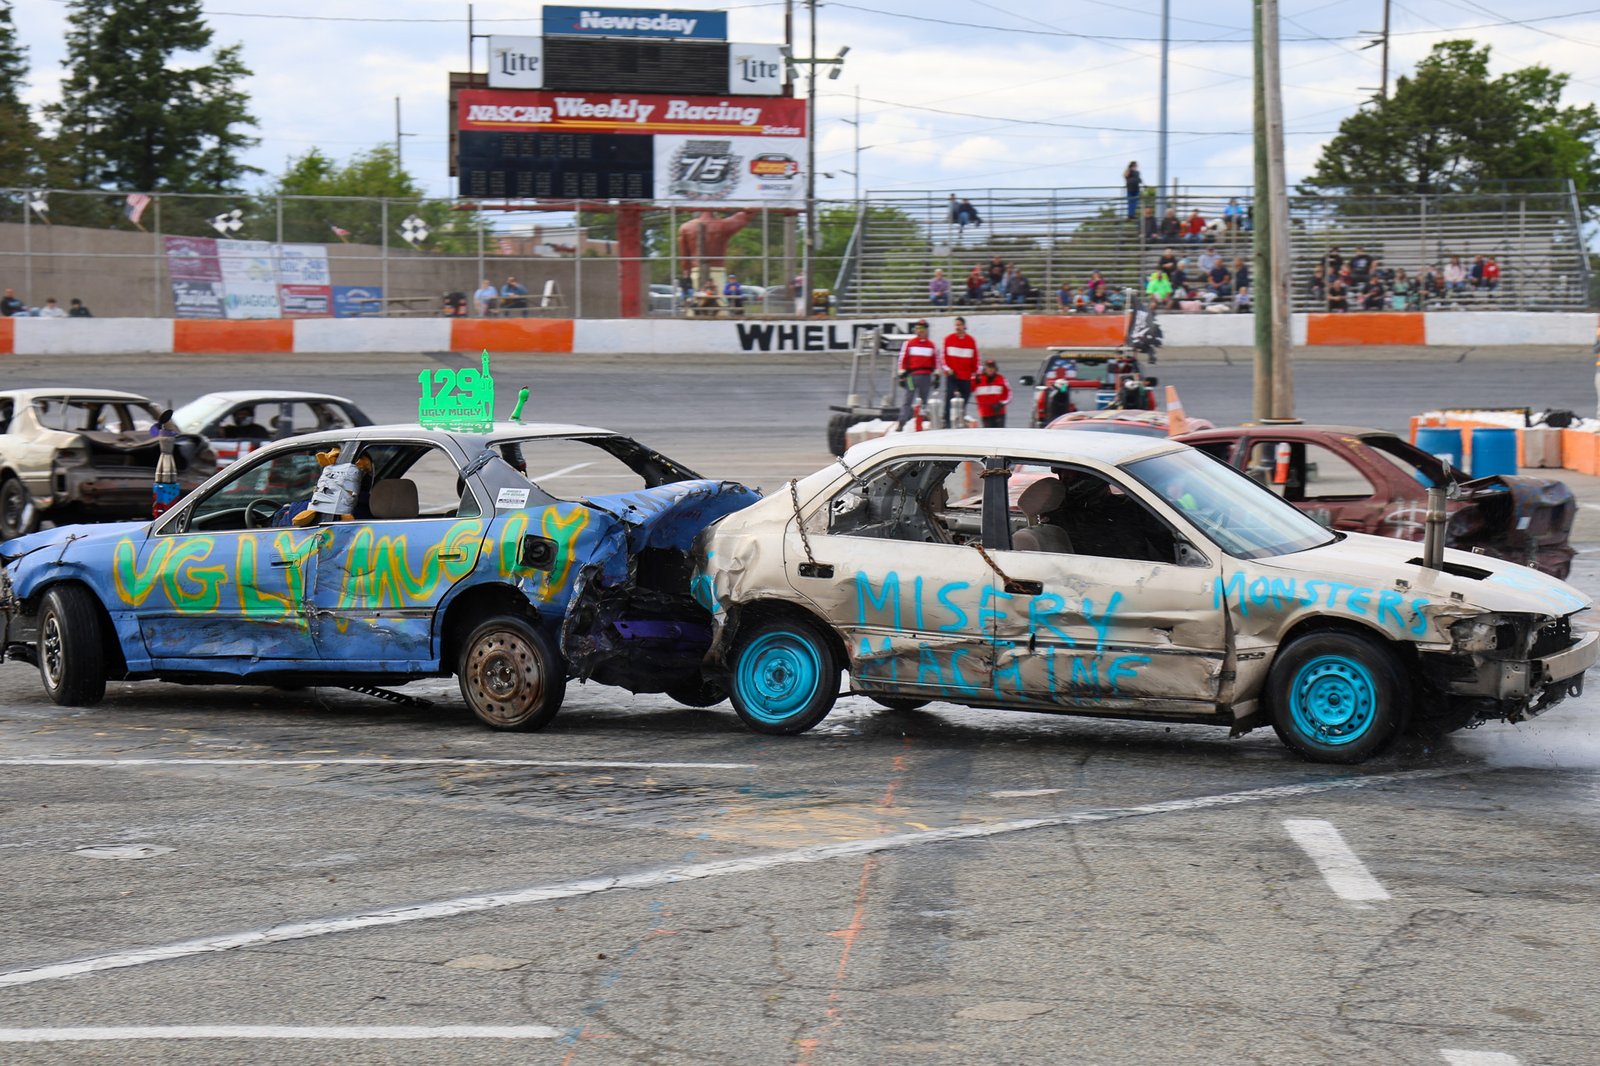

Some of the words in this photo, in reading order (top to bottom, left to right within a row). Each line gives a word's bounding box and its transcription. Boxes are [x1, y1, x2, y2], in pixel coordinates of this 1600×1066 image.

[579, 11, 698, 35] Newsday
[500, 50, 539, 76] Lite
[741, 57, 779, 83] Lite
[467, 104, 553, 123] NASCAR
[554, 97, 655, 123] Weekly
[665, 100, 762, 126] Racing
[762, 124, 801, 136] Series
[681, 155, 729, 183] 75
[418, 368, 481, 406] 129
[421, 408, 446, 417] UGLY
[449, 407, 481, 417] MUGLY
[856, 570, 1125, 655] MISERY
[1212, 570, 1430, 636] MONSTERS
[853, 637, 1152, 700] MACHINE
